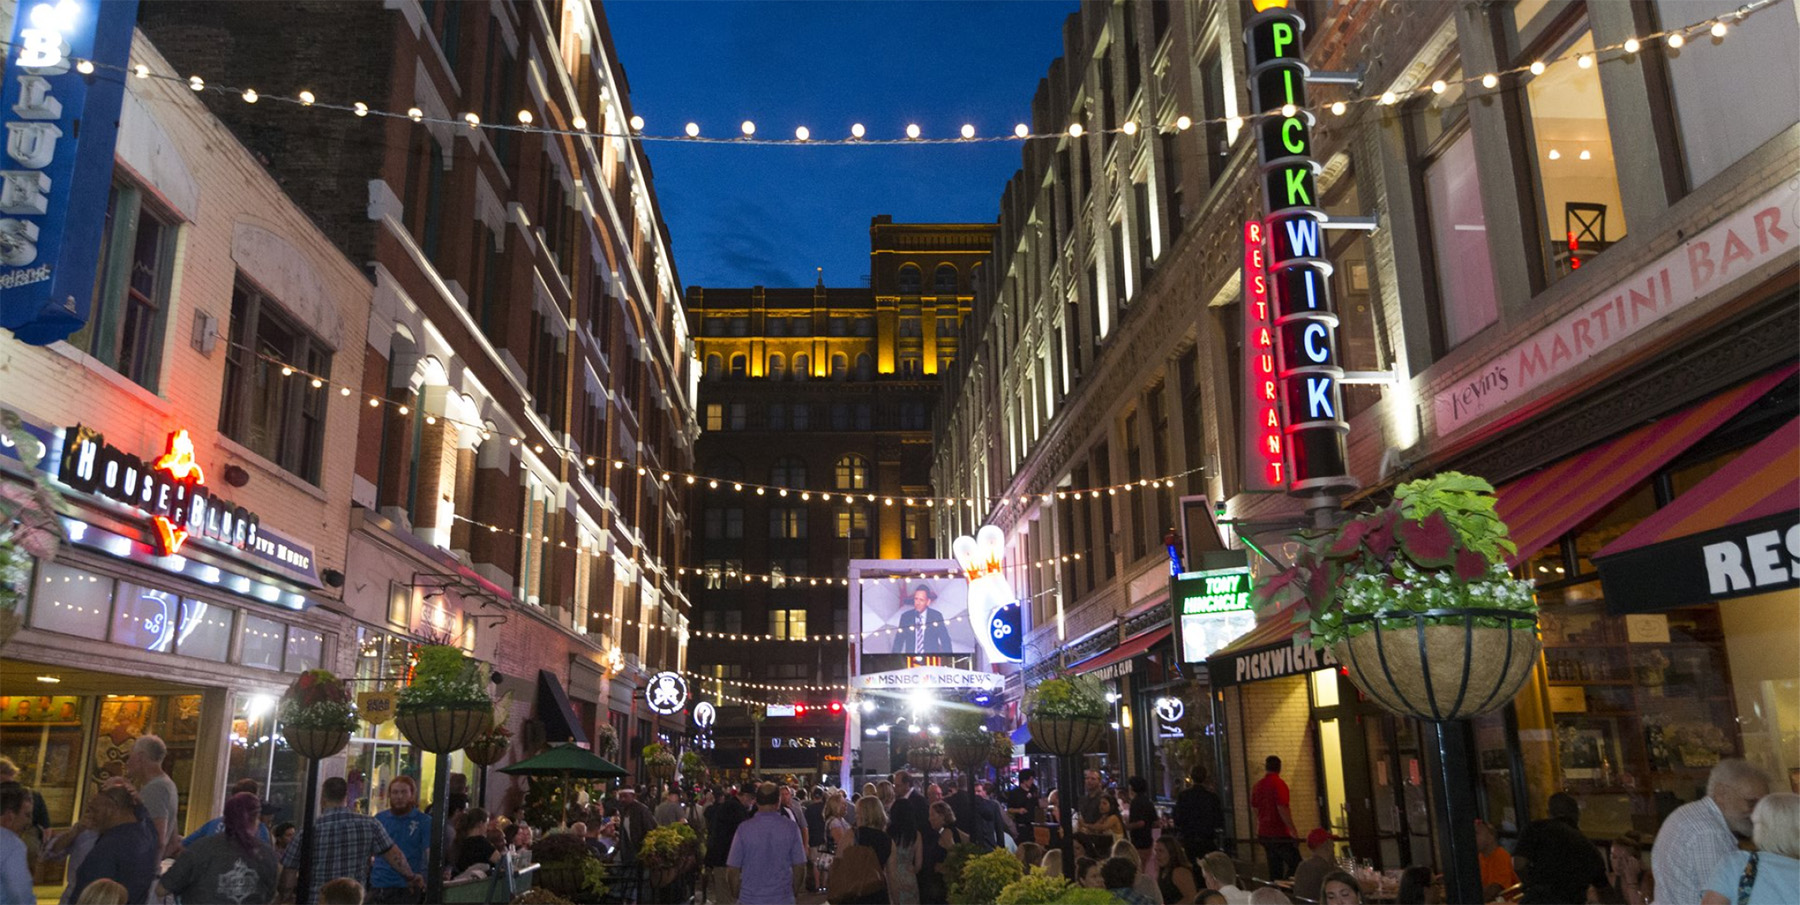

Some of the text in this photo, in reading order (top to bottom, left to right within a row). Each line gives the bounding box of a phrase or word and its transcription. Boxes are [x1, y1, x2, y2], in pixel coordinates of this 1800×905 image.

[0, 28, 71, 267] BLUES
[1272, 22, 1335, 418] PICKWICK
[1250, 223, 1282, 483] RESTAURANT
[1518, 268, 1673, 388] MARTINI
[1685, 206, 1789, 292] BAR
[77, 438, 171, 510] HOUSE
[190, 493, 258, 546] BLUES
[255, 536, 275, 556] IVE
[1205, 574, 1242, 596] TONY
[878, 673, 992, 685] MSNBC NBC NEWS
[1236, 643, 1318, 681] PICKWICK
